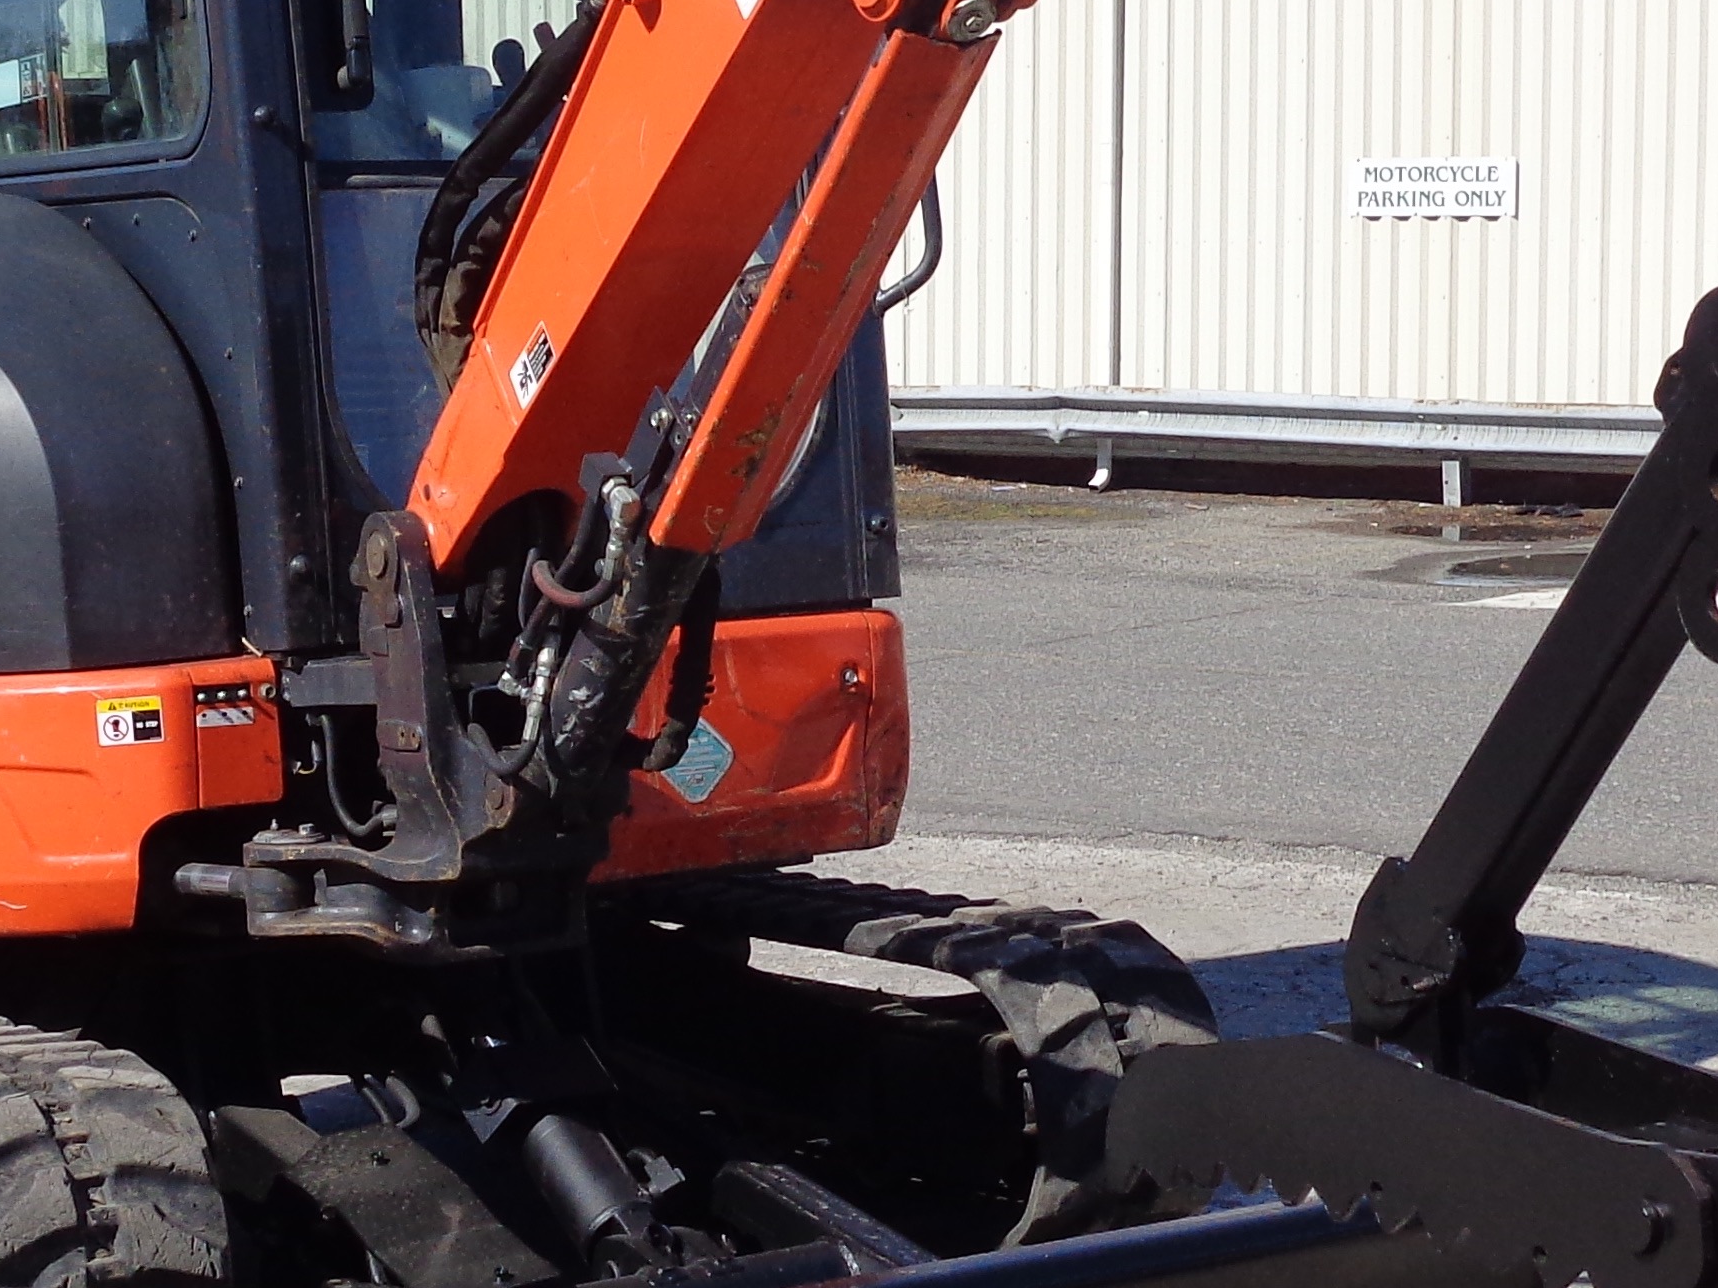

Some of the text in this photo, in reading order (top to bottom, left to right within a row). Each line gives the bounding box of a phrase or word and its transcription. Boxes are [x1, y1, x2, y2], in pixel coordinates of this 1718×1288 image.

[1364, 165, 1500, 183] MOTORCYCLE
[1357, 190, 1507, 208] PARKING ONLY
